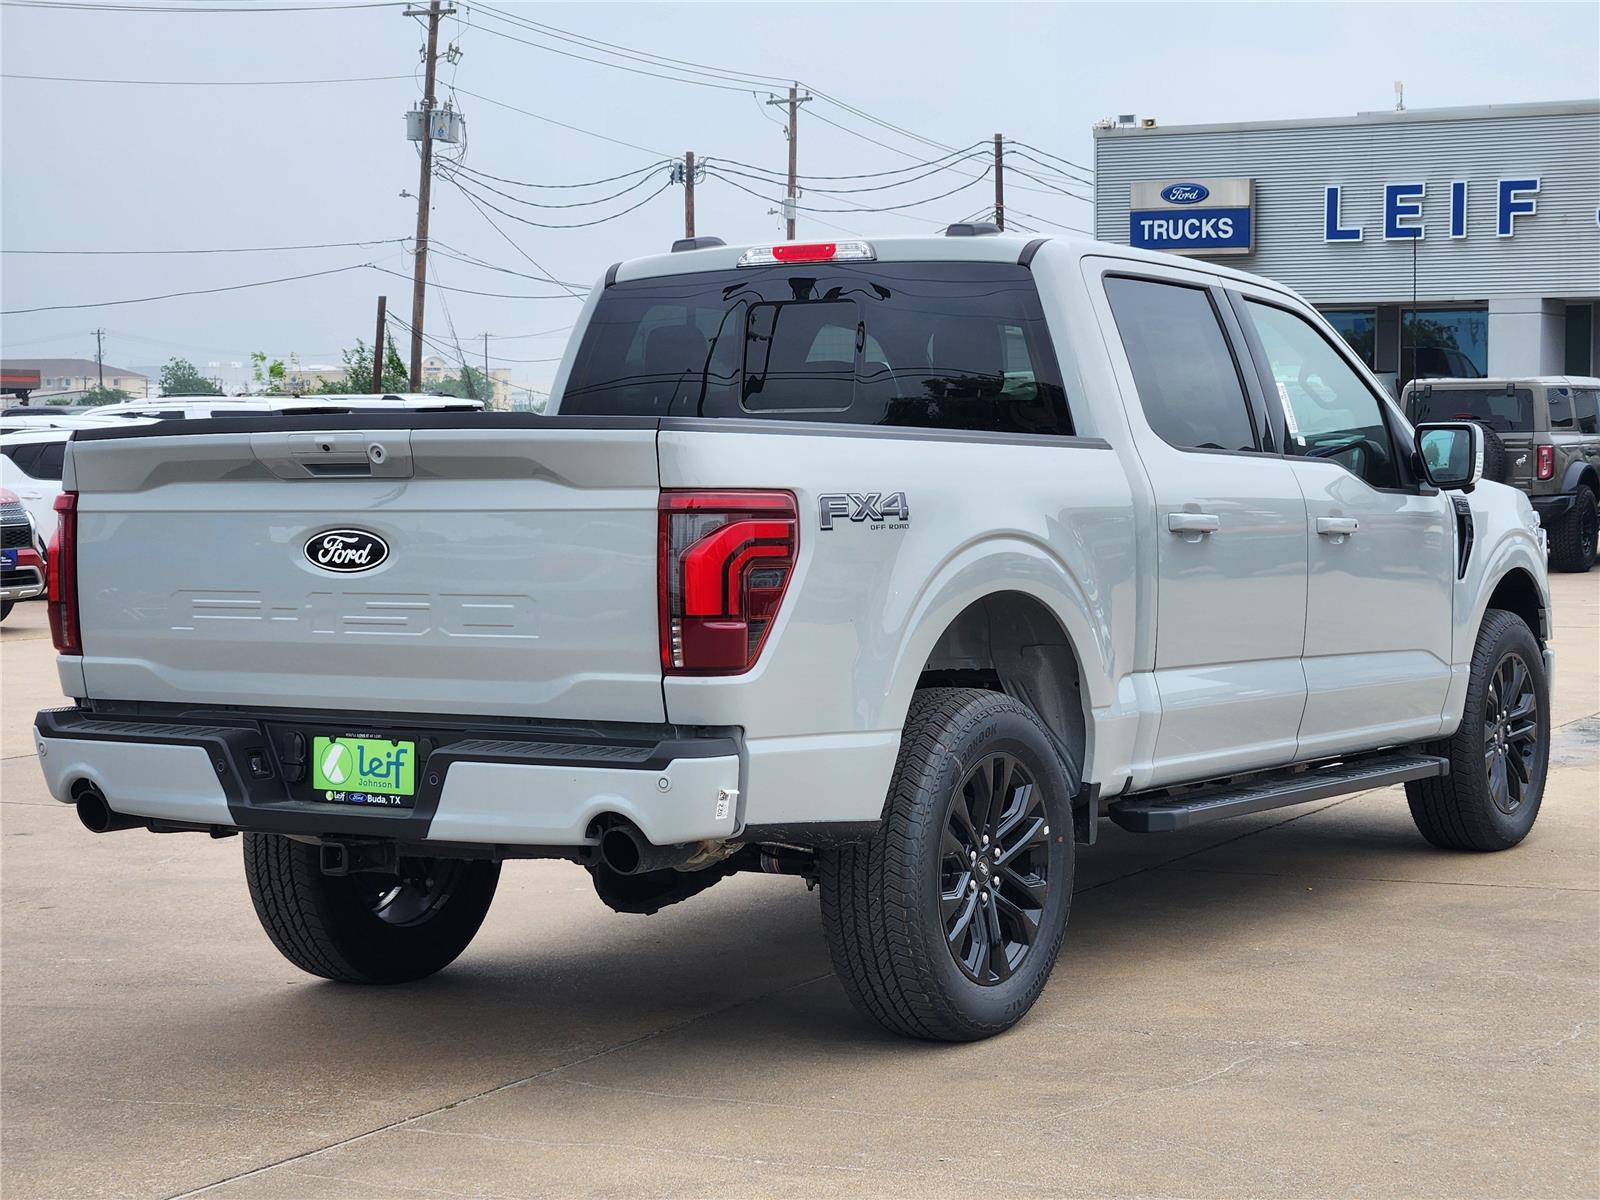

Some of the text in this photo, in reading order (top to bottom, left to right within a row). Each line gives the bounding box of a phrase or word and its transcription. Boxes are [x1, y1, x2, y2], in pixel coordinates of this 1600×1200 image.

[1169, 186, 1199, 200] Ford
[1324, 177, 1541, 242] LEIF
[1140, 217, 1234, 240] TRUCKS
[818, 492, 909, 531] FX4
[317, 534, 372, 565] Ford
[358, 779, 393, 788] Johnson
[367, 794, 388, 804] Buda,
[389, 795, 401, 804] TX
